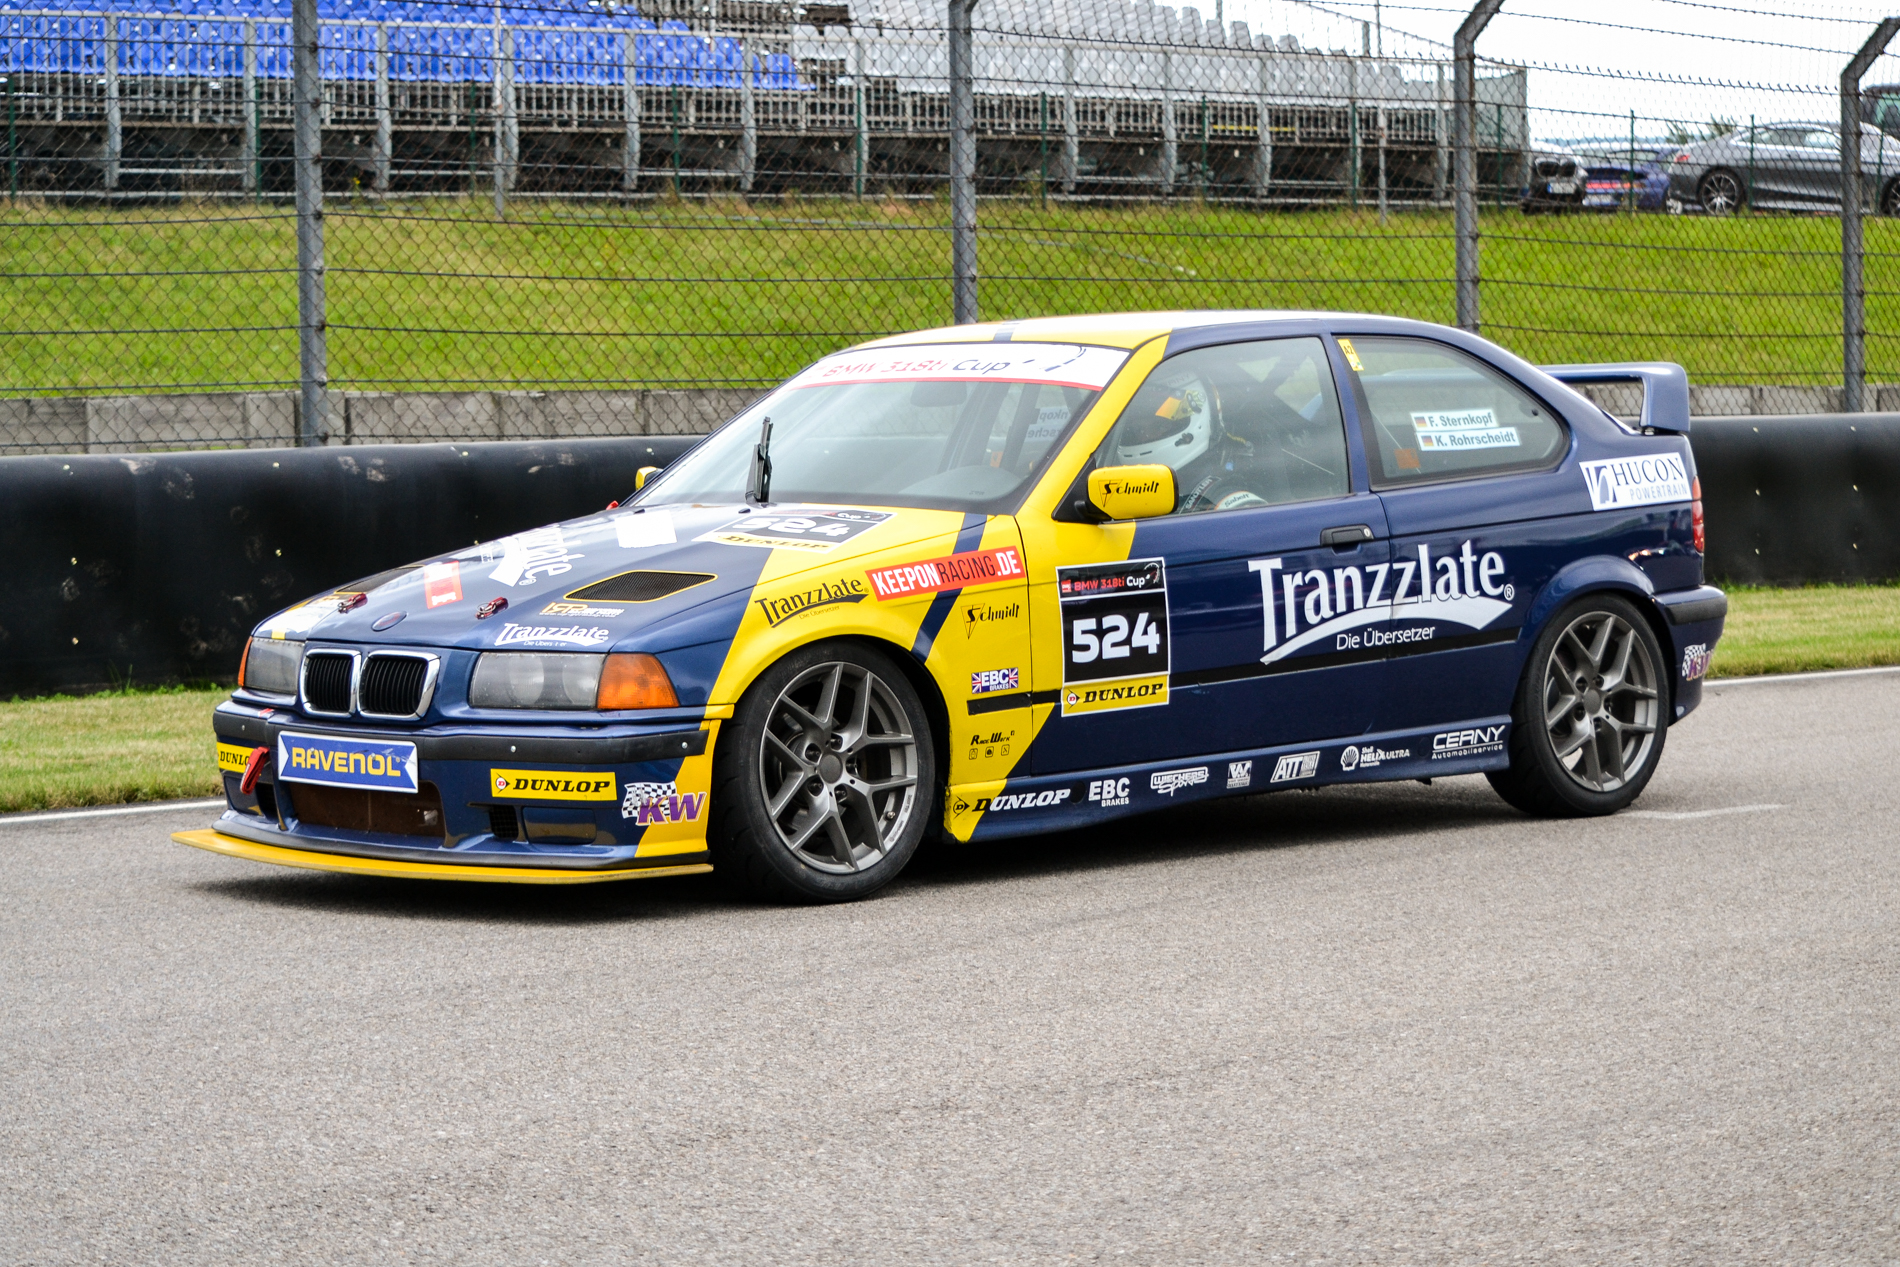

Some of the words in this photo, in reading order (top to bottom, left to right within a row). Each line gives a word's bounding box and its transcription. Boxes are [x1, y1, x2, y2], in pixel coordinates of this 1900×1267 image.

[1343, 345, 1355, 355] A2
[822, 363, 877, 377] BMW
[952, 359, 1011, 374] Cup
[1428, 416, 1439, 428] F.
[1439, 412, 1493, 429] Sternkopf
[1434, 435, 1448, 447] K.
[1450, 431, 1516, 447] Rohrscheidt
[1610, 457, 1684, 486] HUCON
[1102, 480, 1159, 496] Schmidt
[1629, 482, 1688, 500] POWERTRAIN
[731, 517, 851, 537] 524
[724, 535, 829, 550] DUNLOP
[872, 550, 1021, 597] KEEPONRACING.DE
[1074, 579, 1099, 592] BMW
[1101, 576, 1125, 589] 318ti
[1126, 576, 1146, 588] Cup
[810, 605, 841, 617] Übersetzer
[494, 622, 609, 646] Tranzzlate
[1072, 612, 1160, 664] 524
[1336, 633, 1360, 650] Die
[1363, 626, 1436, 647] Übersetzer
[981, 668, 1009, 687] EBC
[989, 683, 1009, 692] BRAKES
[1083, 683, 1163, 703] DUNLOP
[1433, 725, 1506, 750] CERNY
[220, 751, 250, 766] DUNLO
[1386, 749, 1410, 760] ULTRA
[1431, 743, 1504, 760] Automobilservice
[292, 747, 401, 777] RAVENOL
[1273, 756, 1303, 780] ATT
[512, 778, 611, 793] DUNLOP
[1088, 777, 1130, 801] EBC
[635, 791, 707, 826] KW
[972, 788, 1071, 812] DUNLOP
[1101, 796, 1129, 808] BRAKES
